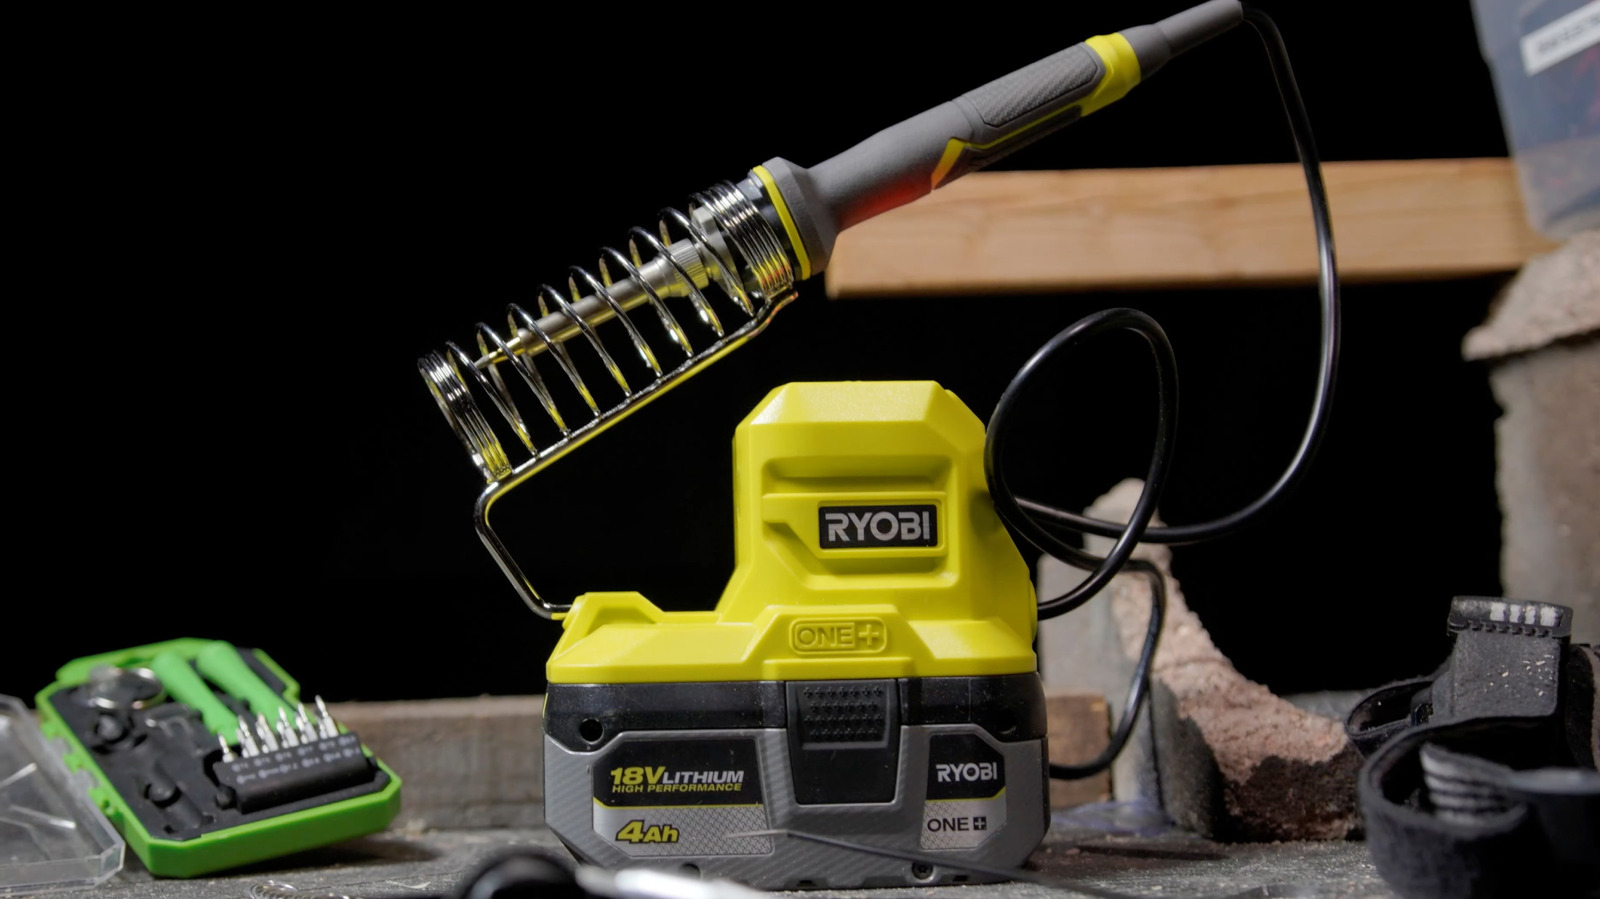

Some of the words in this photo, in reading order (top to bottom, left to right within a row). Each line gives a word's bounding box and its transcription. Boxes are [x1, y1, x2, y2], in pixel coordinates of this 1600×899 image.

[825, 511, 930, 541] RYOBI
[610, 766, 666, 785] 18V
[662, 770, 744, 784] LITHIUM
[935, 762, 997, 782] RYOBI
[612, 784, 643, 793] HIGH
[647, 783, 742, 793] PERFORMANCE
[616, 820, 680, 844] 4Ah
